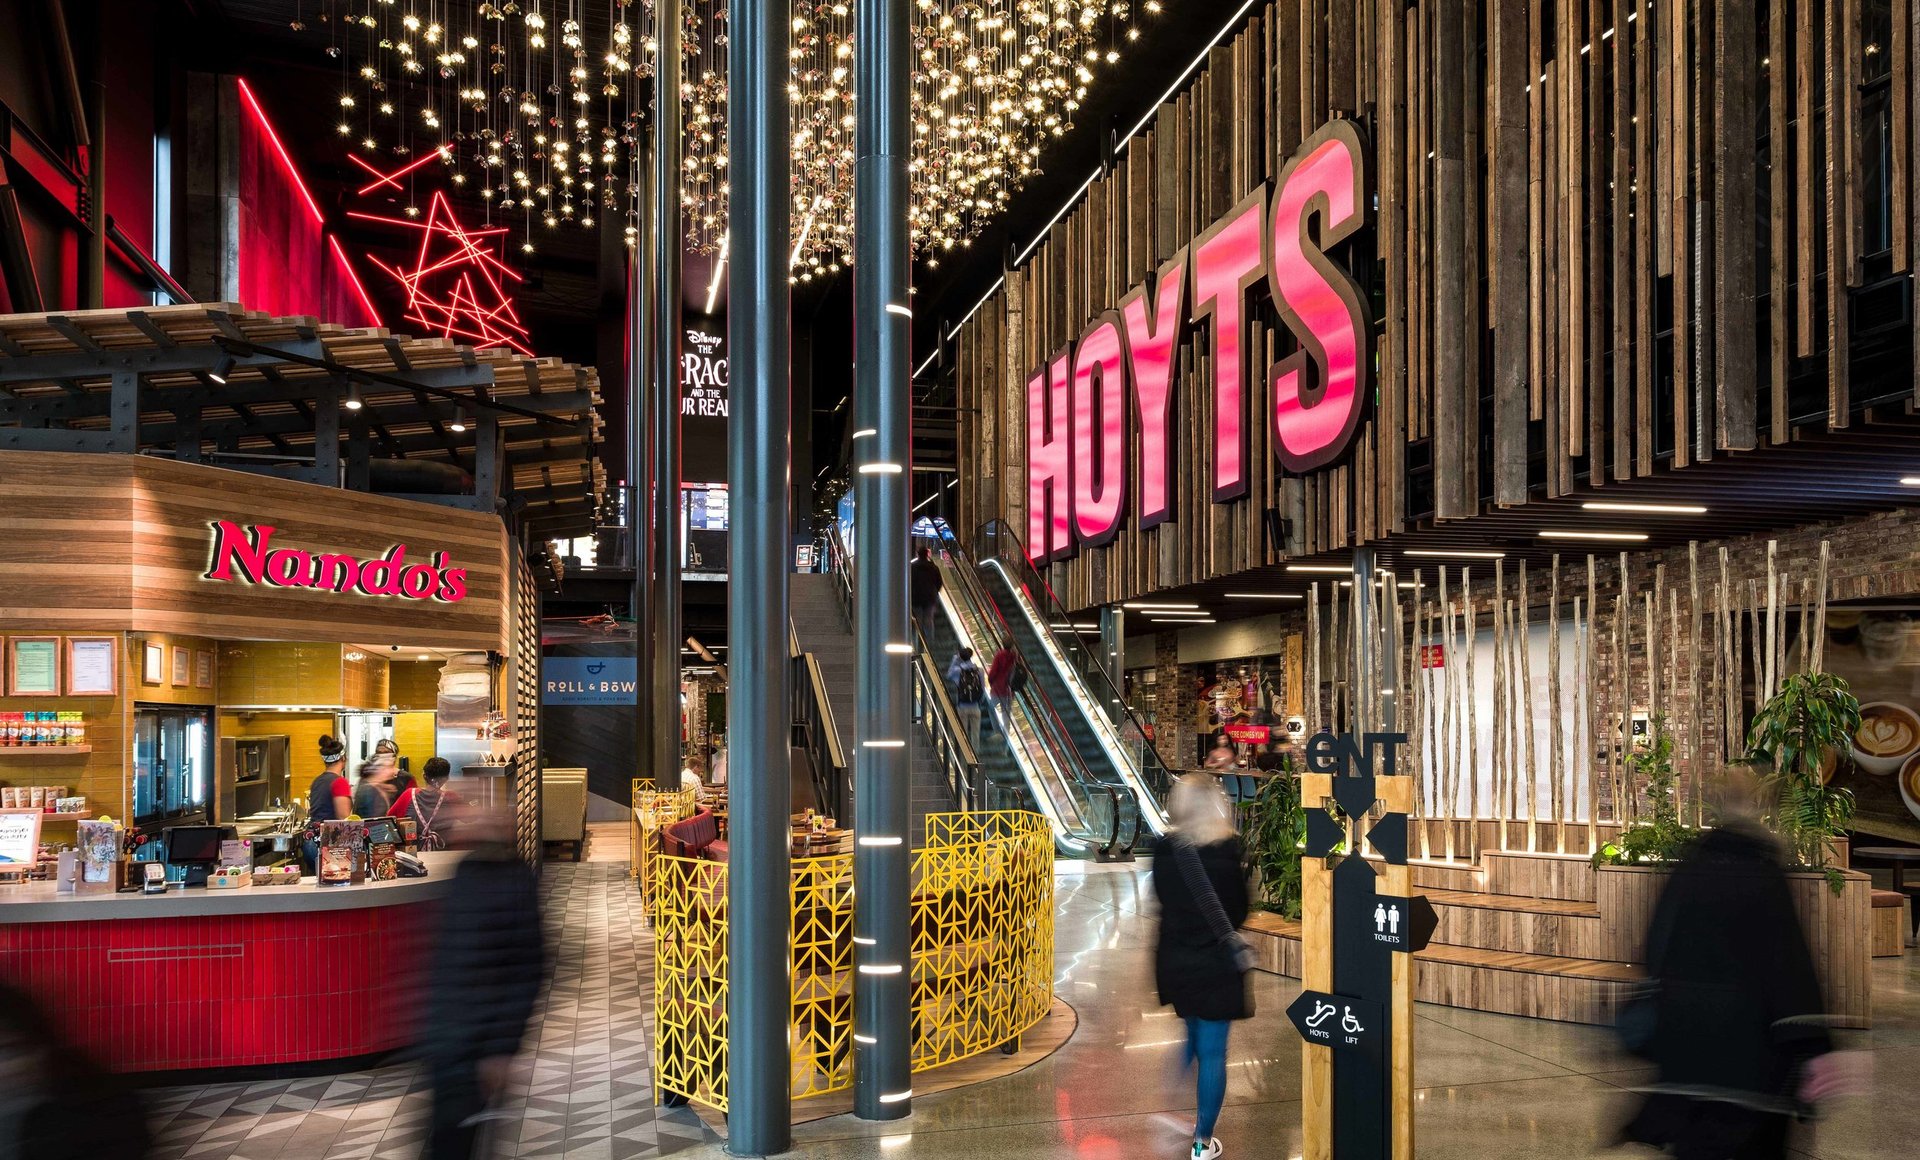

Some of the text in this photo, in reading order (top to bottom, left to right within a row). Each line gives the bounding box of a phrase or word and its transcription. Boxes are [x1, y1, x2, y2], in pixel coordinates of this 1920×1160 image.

[686, 329, 722, 347] Disney
[697, 345, 713, 354] THE
[1027, 122, 1363, 566] HOYTS
[681, 353, 728, 388] RAC
[690, 388, 720, 398] AND THE
[204, 519, 468, 602] Nando's
[1255, 731, 1265, 740] YUM
[1374, 932, 1400, 943] TOILETS
[1309, 1028, 1330, 1039] HOYTS
[1345, 1035, 1359, 1045] LIFT
